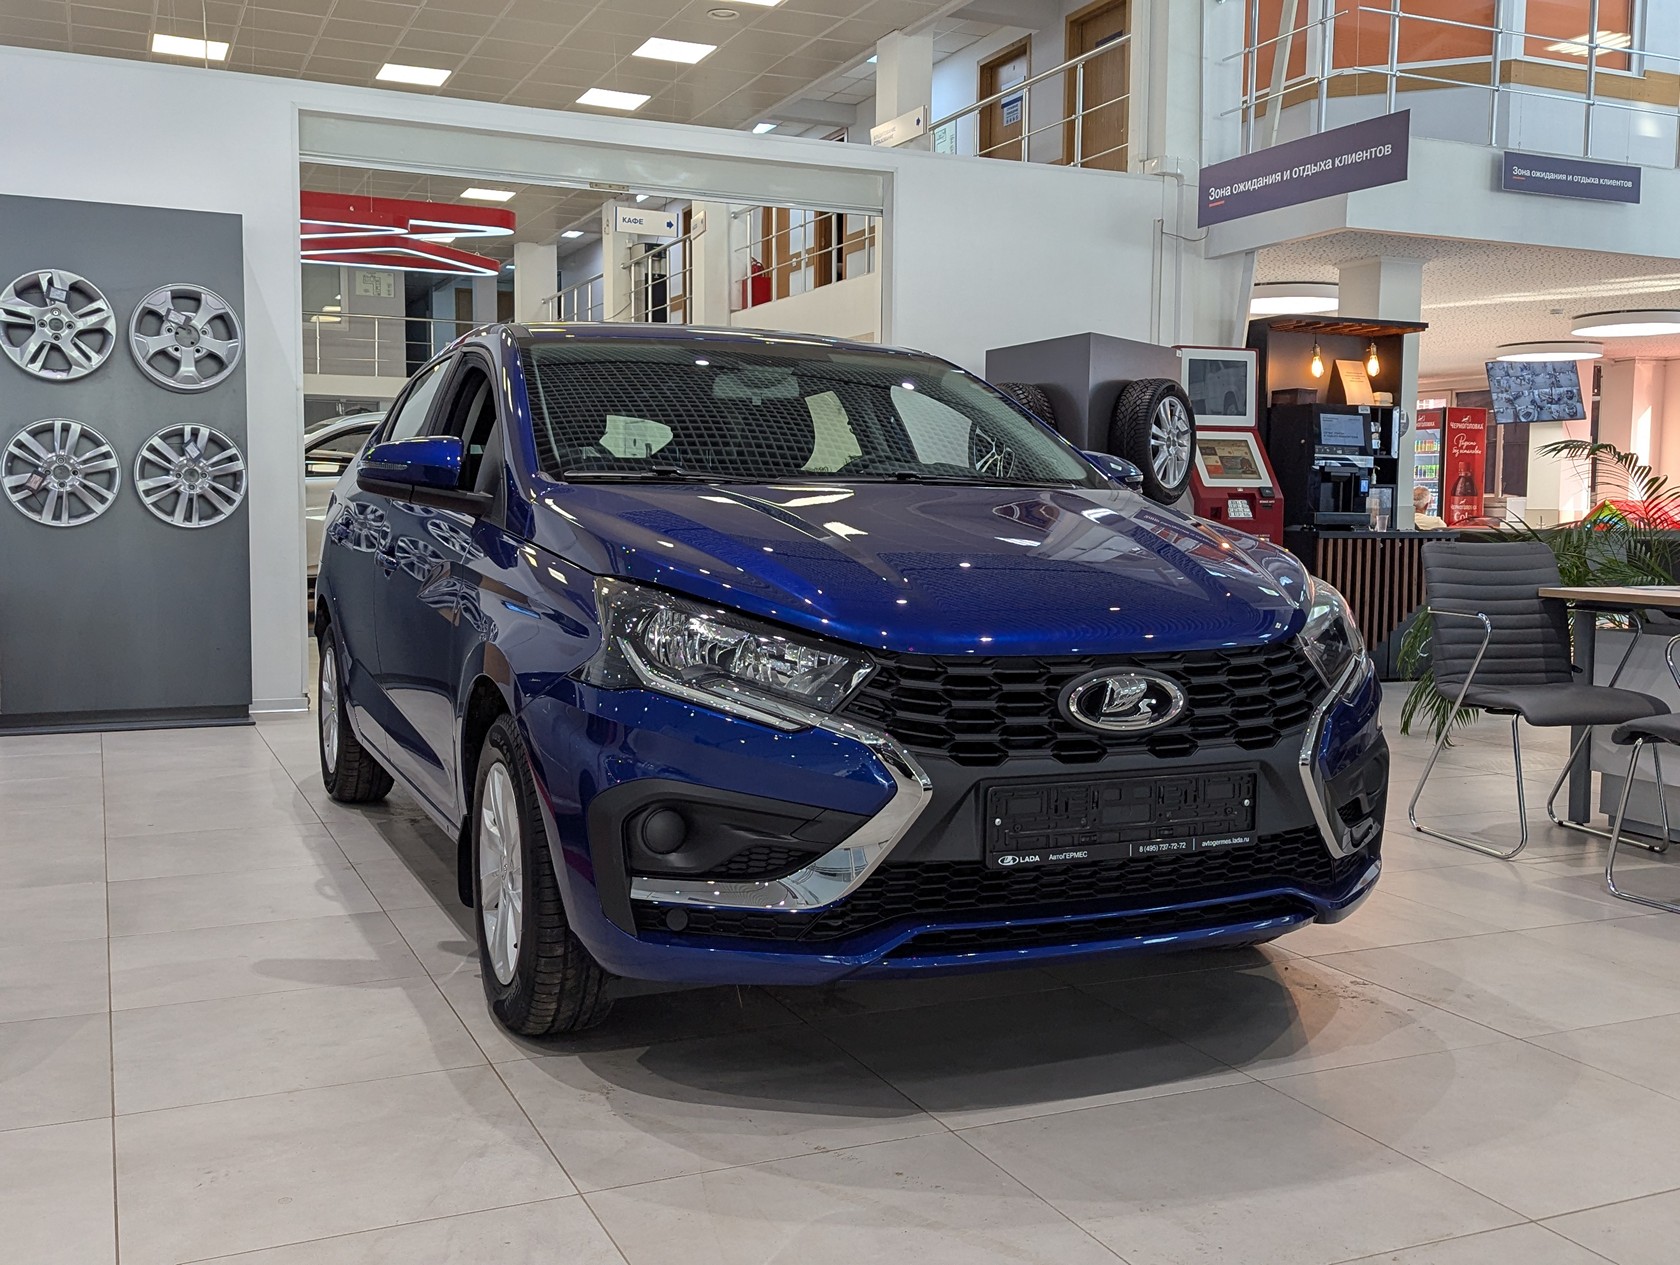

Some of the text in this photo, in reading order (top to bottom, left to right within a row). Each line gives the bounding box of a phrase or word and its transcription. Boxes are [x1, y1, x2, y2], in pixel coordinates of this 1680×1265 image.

[1208, 143, 1392, 201] Зона ожидания и отдыха клиентов
[1512, 166, 1530, 177] Зона
[1531, 170, 1567, 181] ожидания
[1573, 174, 1599, 184] отдыха
[1599, 178, 1633, 188] клиентов
[622, 216, 644, 225] КАФЕ
[1139, 841, 1187, 853] 8 (495) 737-72-72
[1201, 837, 1250, 847] avtogermes.lada.ru
[1020, 855, 1040, 863] LADA
[1048, 851, 1088, 861] АвтоГЕРМЕС
